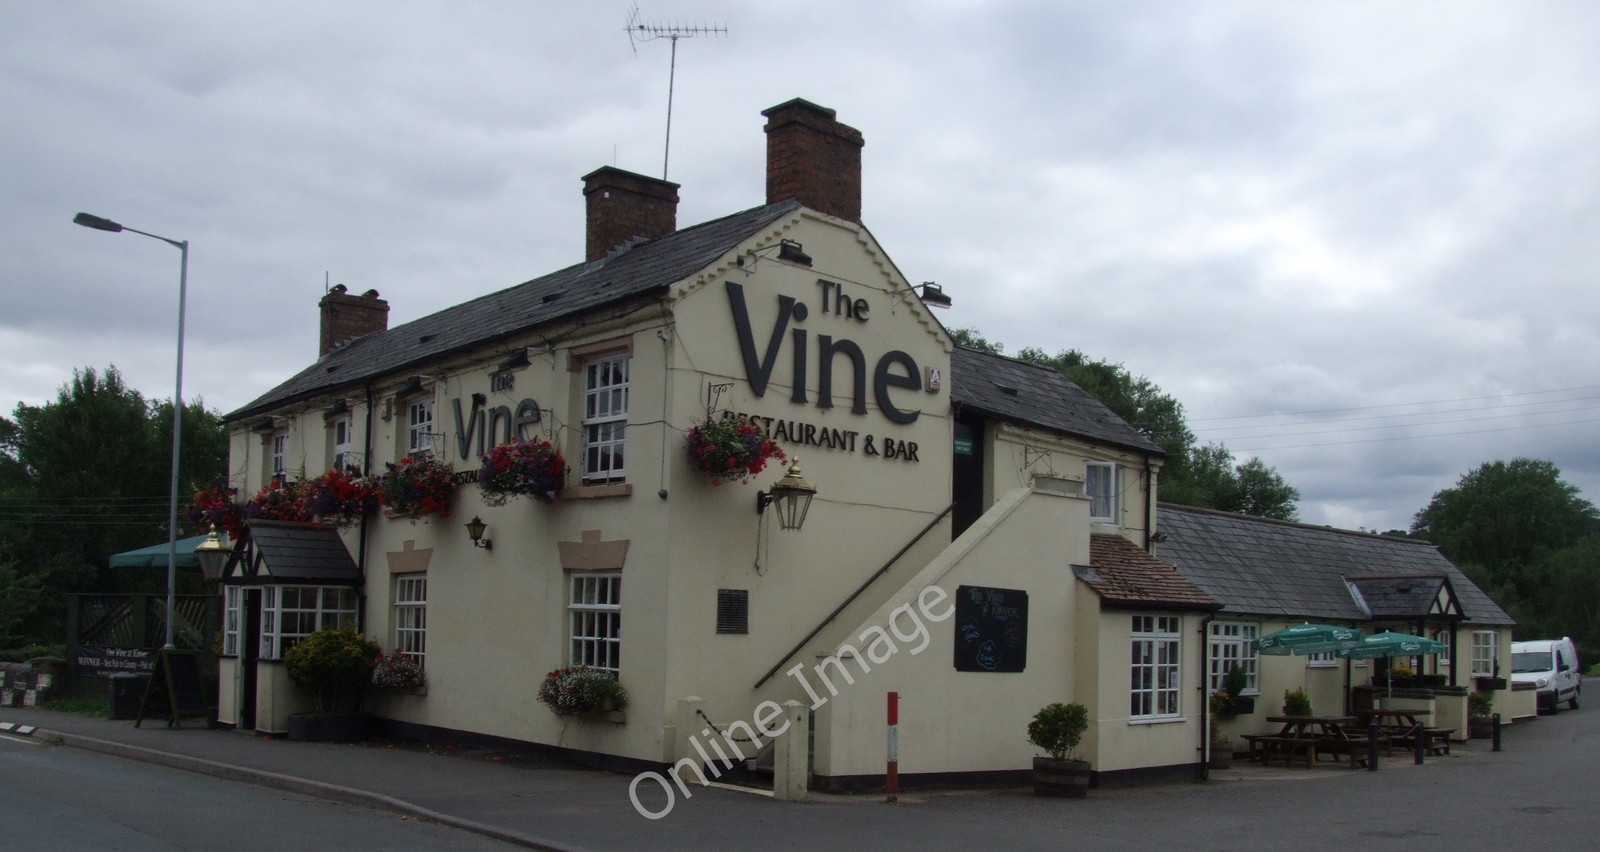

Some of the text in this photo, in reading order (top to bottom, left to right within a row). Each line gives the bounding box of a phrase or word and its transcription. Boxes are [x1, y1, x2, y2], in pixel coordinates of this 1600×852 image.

[817, 278, 870, 322] The
[725, 281, 922, 425] Vine
[489, 370, 515, 393] The
[452, 392, 540, 460] Vine
[723, 410, 920, 463] STAURANT & BAR
[78, 656, 101, 666] WINNER
[116, 648, 127, 657] Vine
